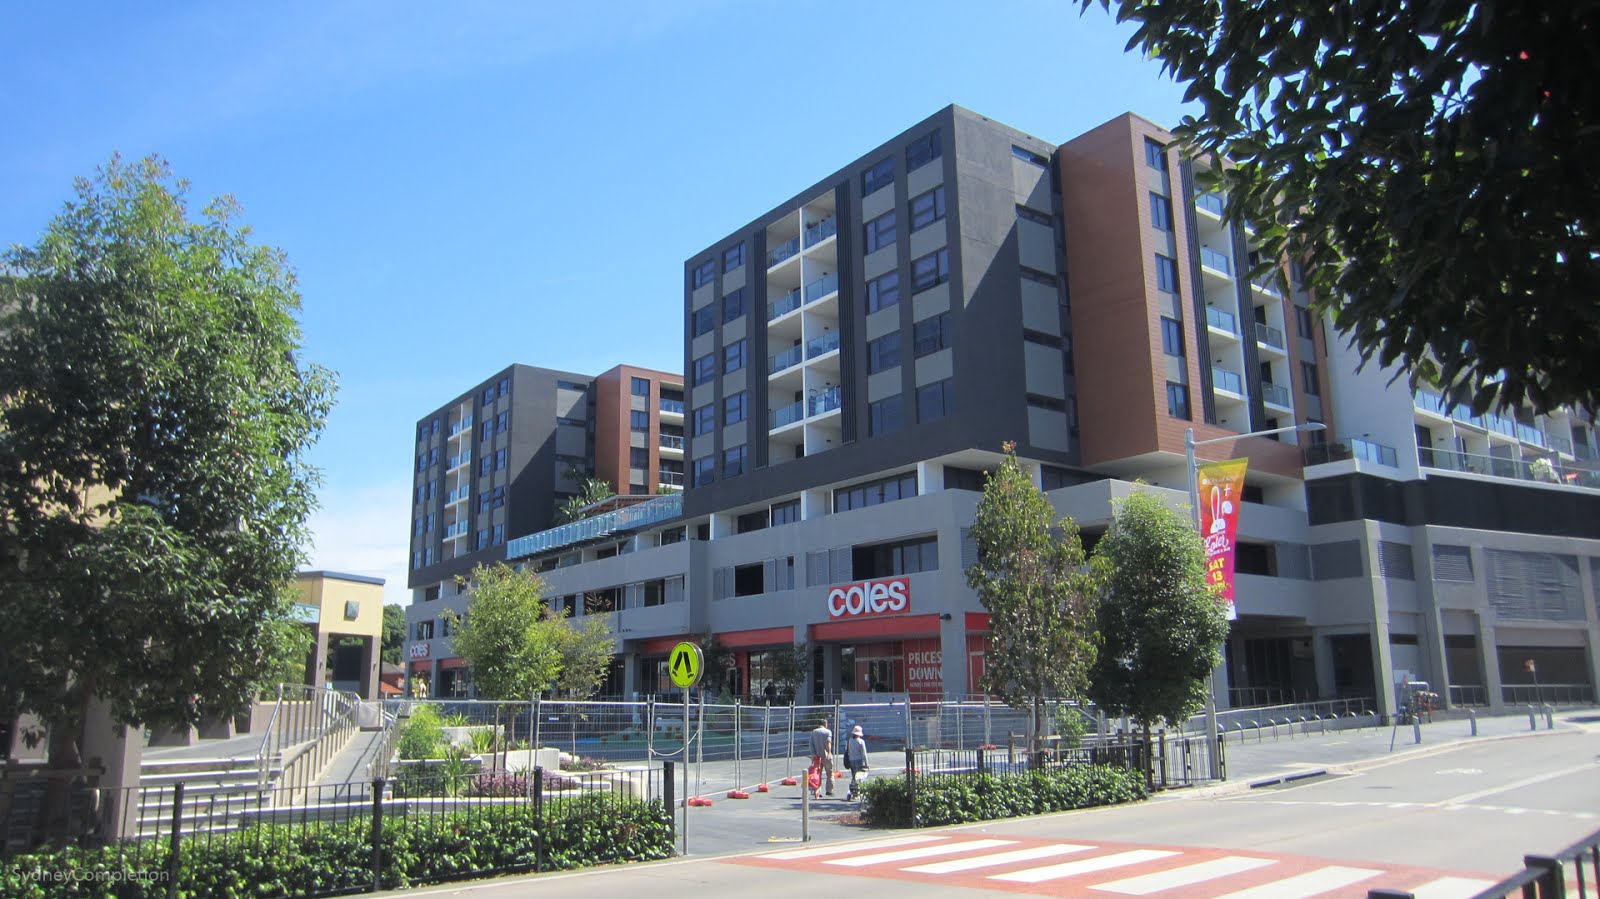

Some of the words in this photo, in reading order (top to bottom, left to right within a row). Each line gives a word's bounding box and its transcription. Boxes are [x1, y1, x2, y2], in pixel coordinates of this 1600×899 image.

[1208, 557, 1225, 571] SAT
[1212, 570, 1223, 582] 13
[828, 581, 907, 617] coles
[908, 651, 942, 664] PRICES
[909, 667, 943, 680] DOWN
